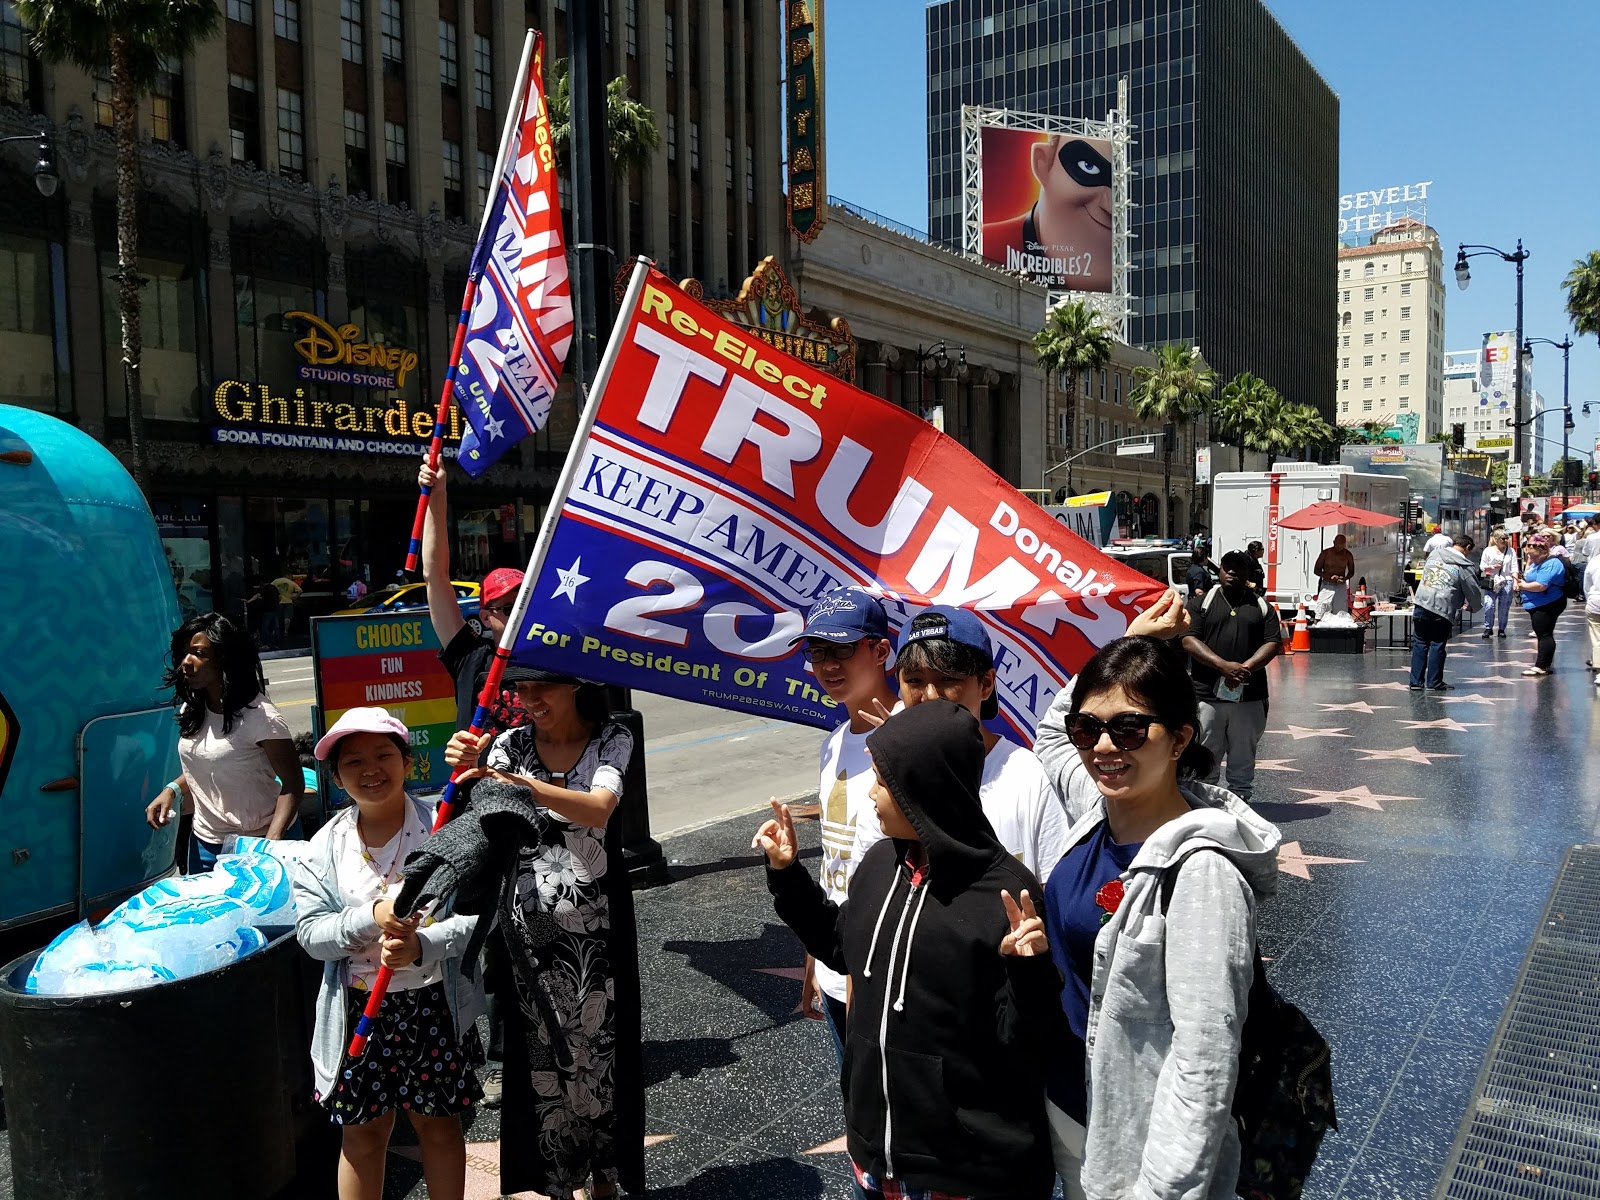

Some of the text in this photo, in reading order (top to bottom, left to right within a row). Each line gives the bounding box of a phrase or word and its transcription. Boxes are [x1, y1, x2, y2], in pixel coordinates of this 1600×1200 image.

[1339, 181, 1433, 211] SEVELT
[1338, 211, 1400, 235] OTEL
[1006, 244, 1092, 276] INCREDIBLES 2
[1052, 244, 1074, 252] PIXAR
[1036, 275, 1065, 285] JUNE 15
[641, 283, 827, 410] Re-Elect
[1486, 347, 1509, 363] E3
[300, 367, 395, 389] STUDIO STORE
[214, 380, 466, 440] Ghirardel
[217, 429, 459, 458] SODA FOUNTAIN AND CHOCOLAT SH
[579, 453, 704, 526] KEEP
[356, 621, 422, 649] CHOOSE
[921, 628, 943, 636] VEGAS
[381, 657, 403, 674] FUN
[526, 622, 838, 708] For President Of The
[365, 681, 422, 702] KINDNESS
[702, 688, 826, 720] TRUMP2020SWAG.COM
[409, 729, 429, 746] BES
